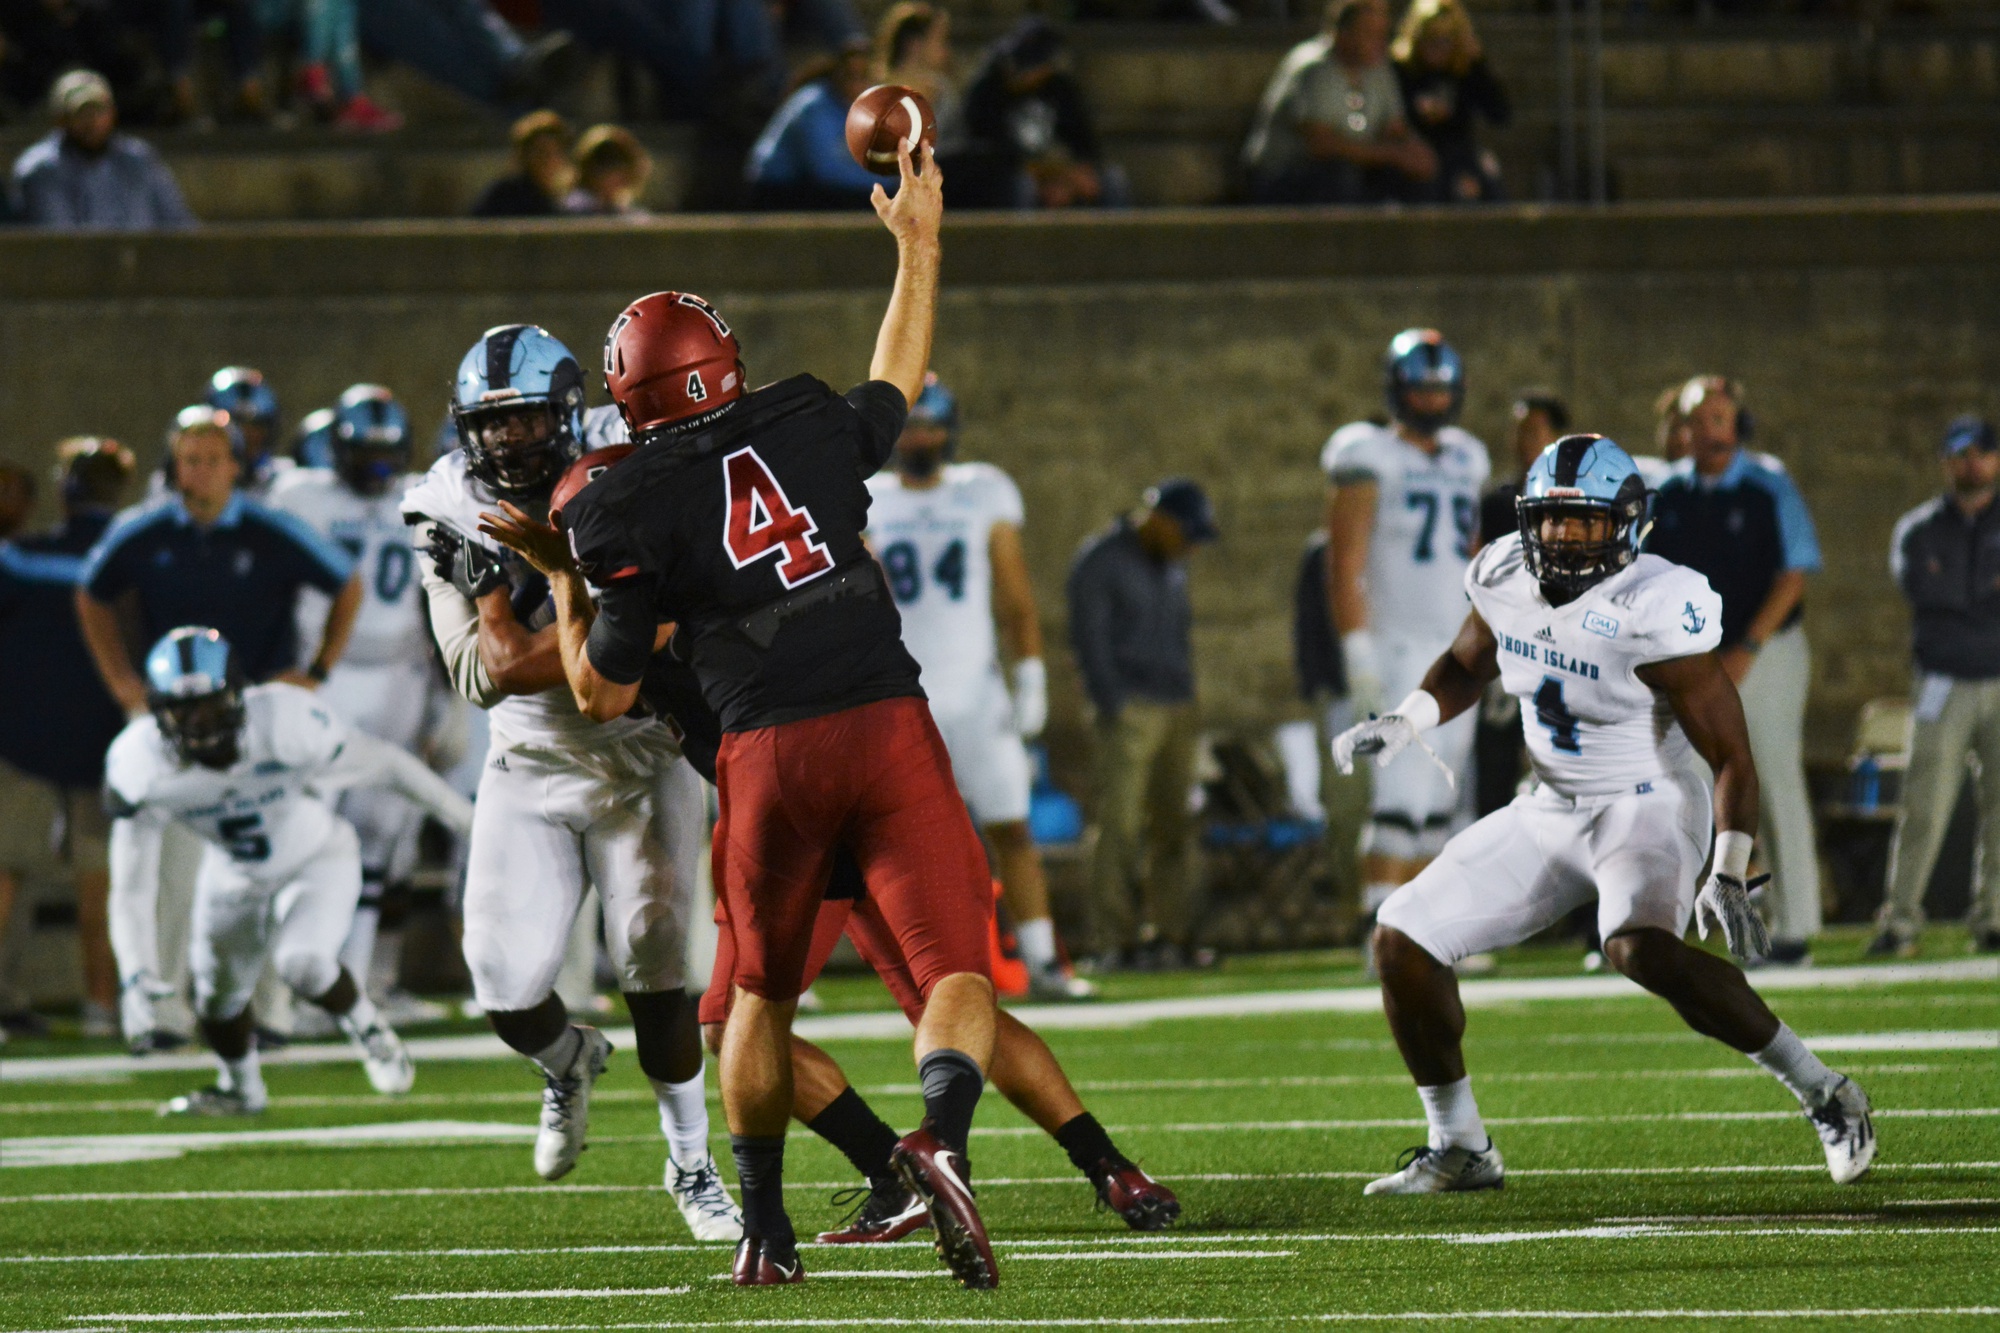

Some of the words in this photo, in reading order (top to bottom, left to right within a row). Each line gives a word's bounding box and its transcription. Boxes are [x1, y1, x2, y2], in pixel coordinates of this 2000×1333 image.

[686, 370, 708, 403] 4
[688, 419, 700, 429] OF
[723, 445, 836, 591] 4
[882, 538, 967, 605] 84
[1543, 647, 1600, 681] ISLAND
[1532, 674, 1582, 756] 4
[217, 812, 272, 863] 5
